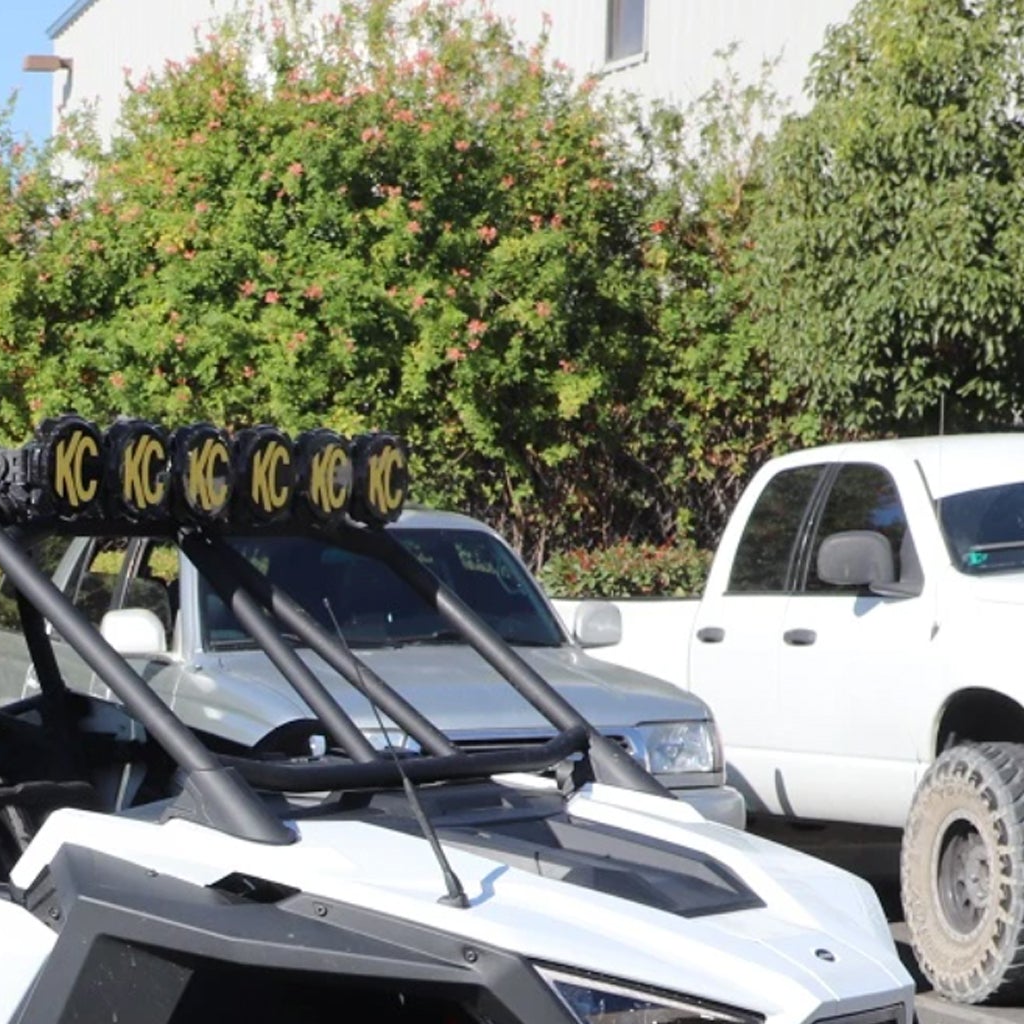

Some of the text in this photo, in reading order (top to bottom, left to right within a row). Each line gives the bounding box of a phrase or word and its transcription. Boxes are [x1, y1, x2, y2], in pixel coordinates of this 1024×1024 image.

[56, 431, 98, 506] KC
[123, 435, 164, 509] KC
[189, 439, 228, 511] KC
[252, 441, 290, 512] KC
[311, 444, 347, 513] KC
[369, 445, 403, 514] KC
